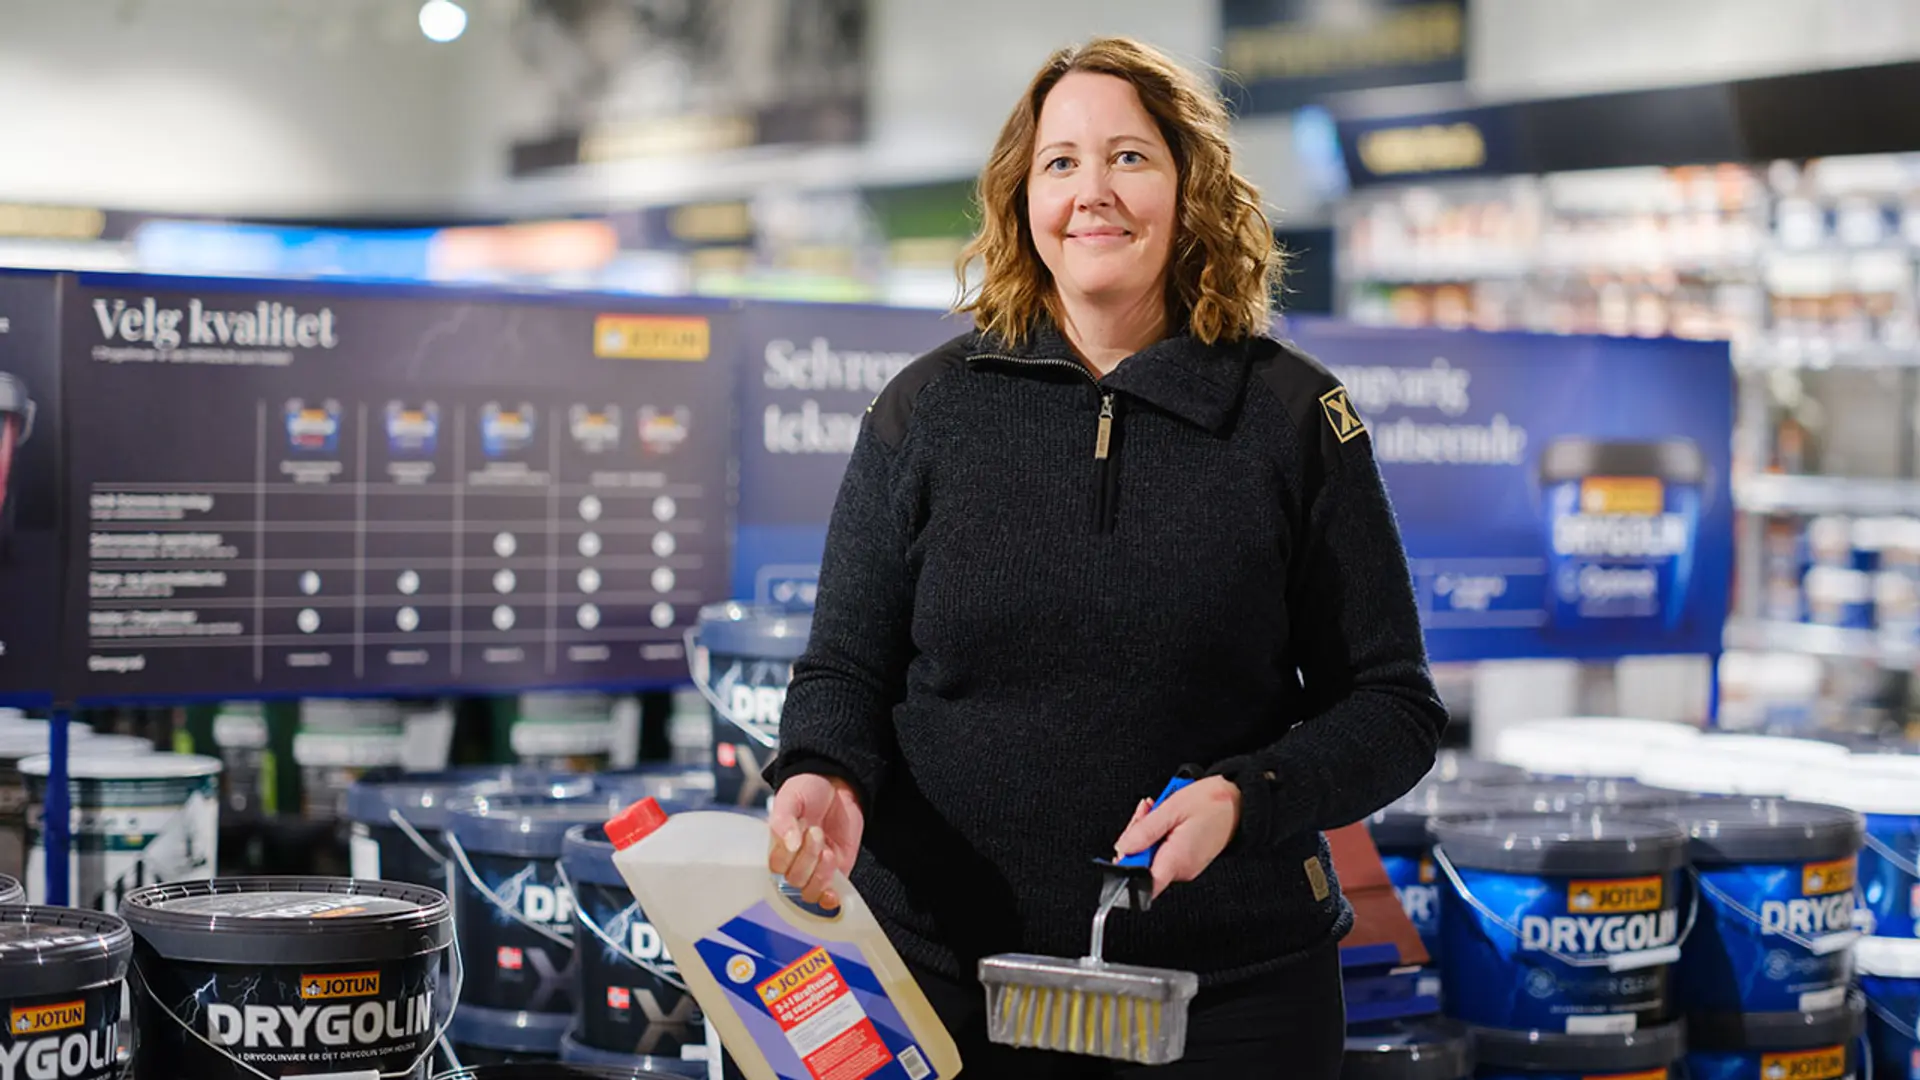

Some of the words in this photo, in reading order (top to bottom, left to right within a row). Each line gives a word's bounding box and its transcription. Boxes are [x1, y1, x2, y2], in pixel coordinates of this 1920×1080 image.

[93, 297, 183, 350] Velg
[189, 298, 338, 348] kvalitet
[763, 400, 864, 454] tekn
[1522, 909, 1678, 952] DRYGOLIN
[323, 977, 377, 995] JOTUN
[778, 953, 828, 992] JOTUN
[34, 1006, 82, 1029] JOTUN
[208, 990, 434, 1048] DRYGOLIN
[308, 1052, 320, 1061] ER
[322, 1051, 338, 1062] DET
[340, 1049, 378, 1060] DRYGOLIN
